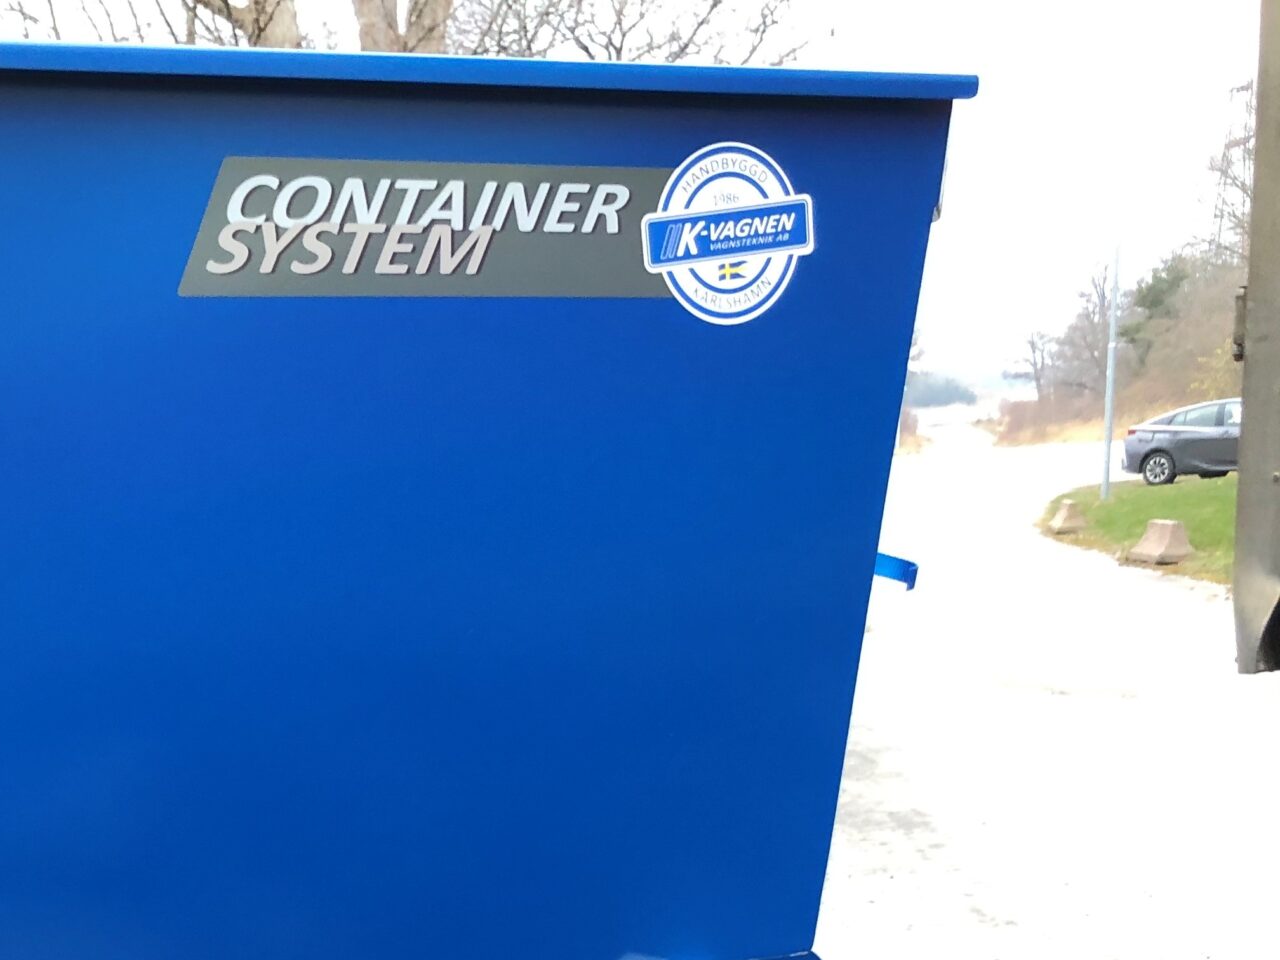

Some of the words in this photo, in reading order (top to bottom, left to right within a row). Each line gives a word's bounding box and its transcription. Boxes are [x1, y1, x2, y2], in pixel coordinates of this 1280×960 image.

[681, 156, 769, 193] HANDBYGGD
[226, 174, 631, 235] CONTAINER
[712, 192, 740, 207] 1986
[205, 220, 498, 276] SYSTEM
[676, 211, 796, 258] K-VAGNEN
[710, 235, 774, 251] VAGNSTEKNIK
[776, 233, 790, 242] AB
